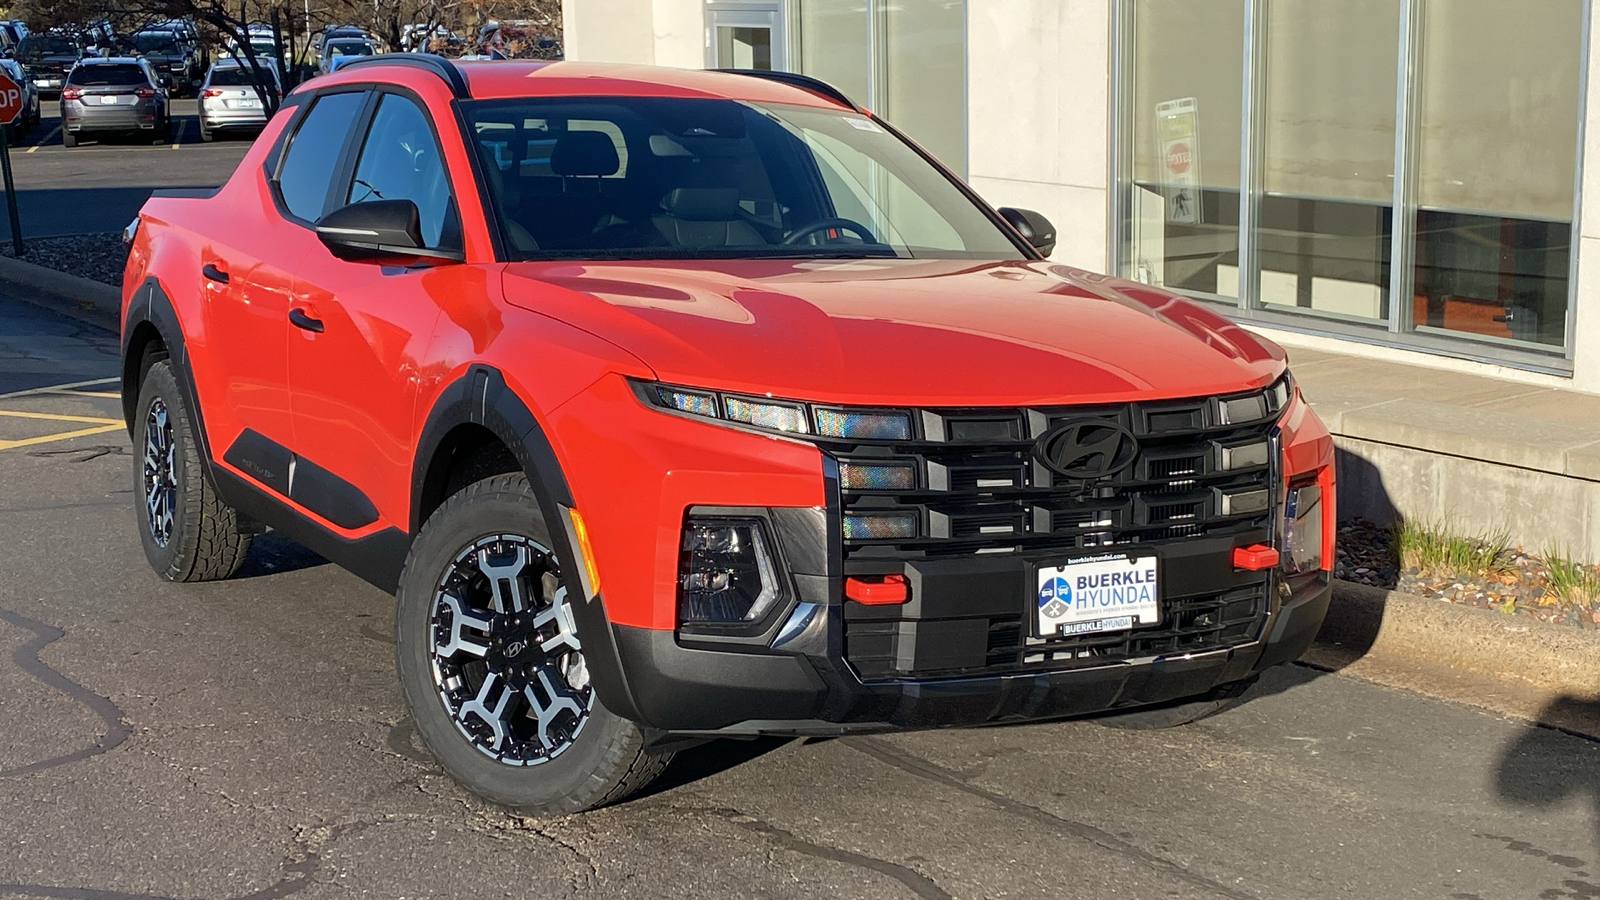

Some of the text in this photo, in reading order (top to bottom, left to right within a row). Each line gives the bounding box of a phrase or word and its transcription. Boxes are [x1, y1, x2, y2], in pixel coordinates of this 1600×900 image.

[1067, 553, 1127, 565] buerklehyundai.com
[1076, 569, 1155, 590] BUERKLE
[1076, 584, 1157, 610] HYUNDAI
[1064, 618, 1131, 634] BUERKLE HYUNDAI
